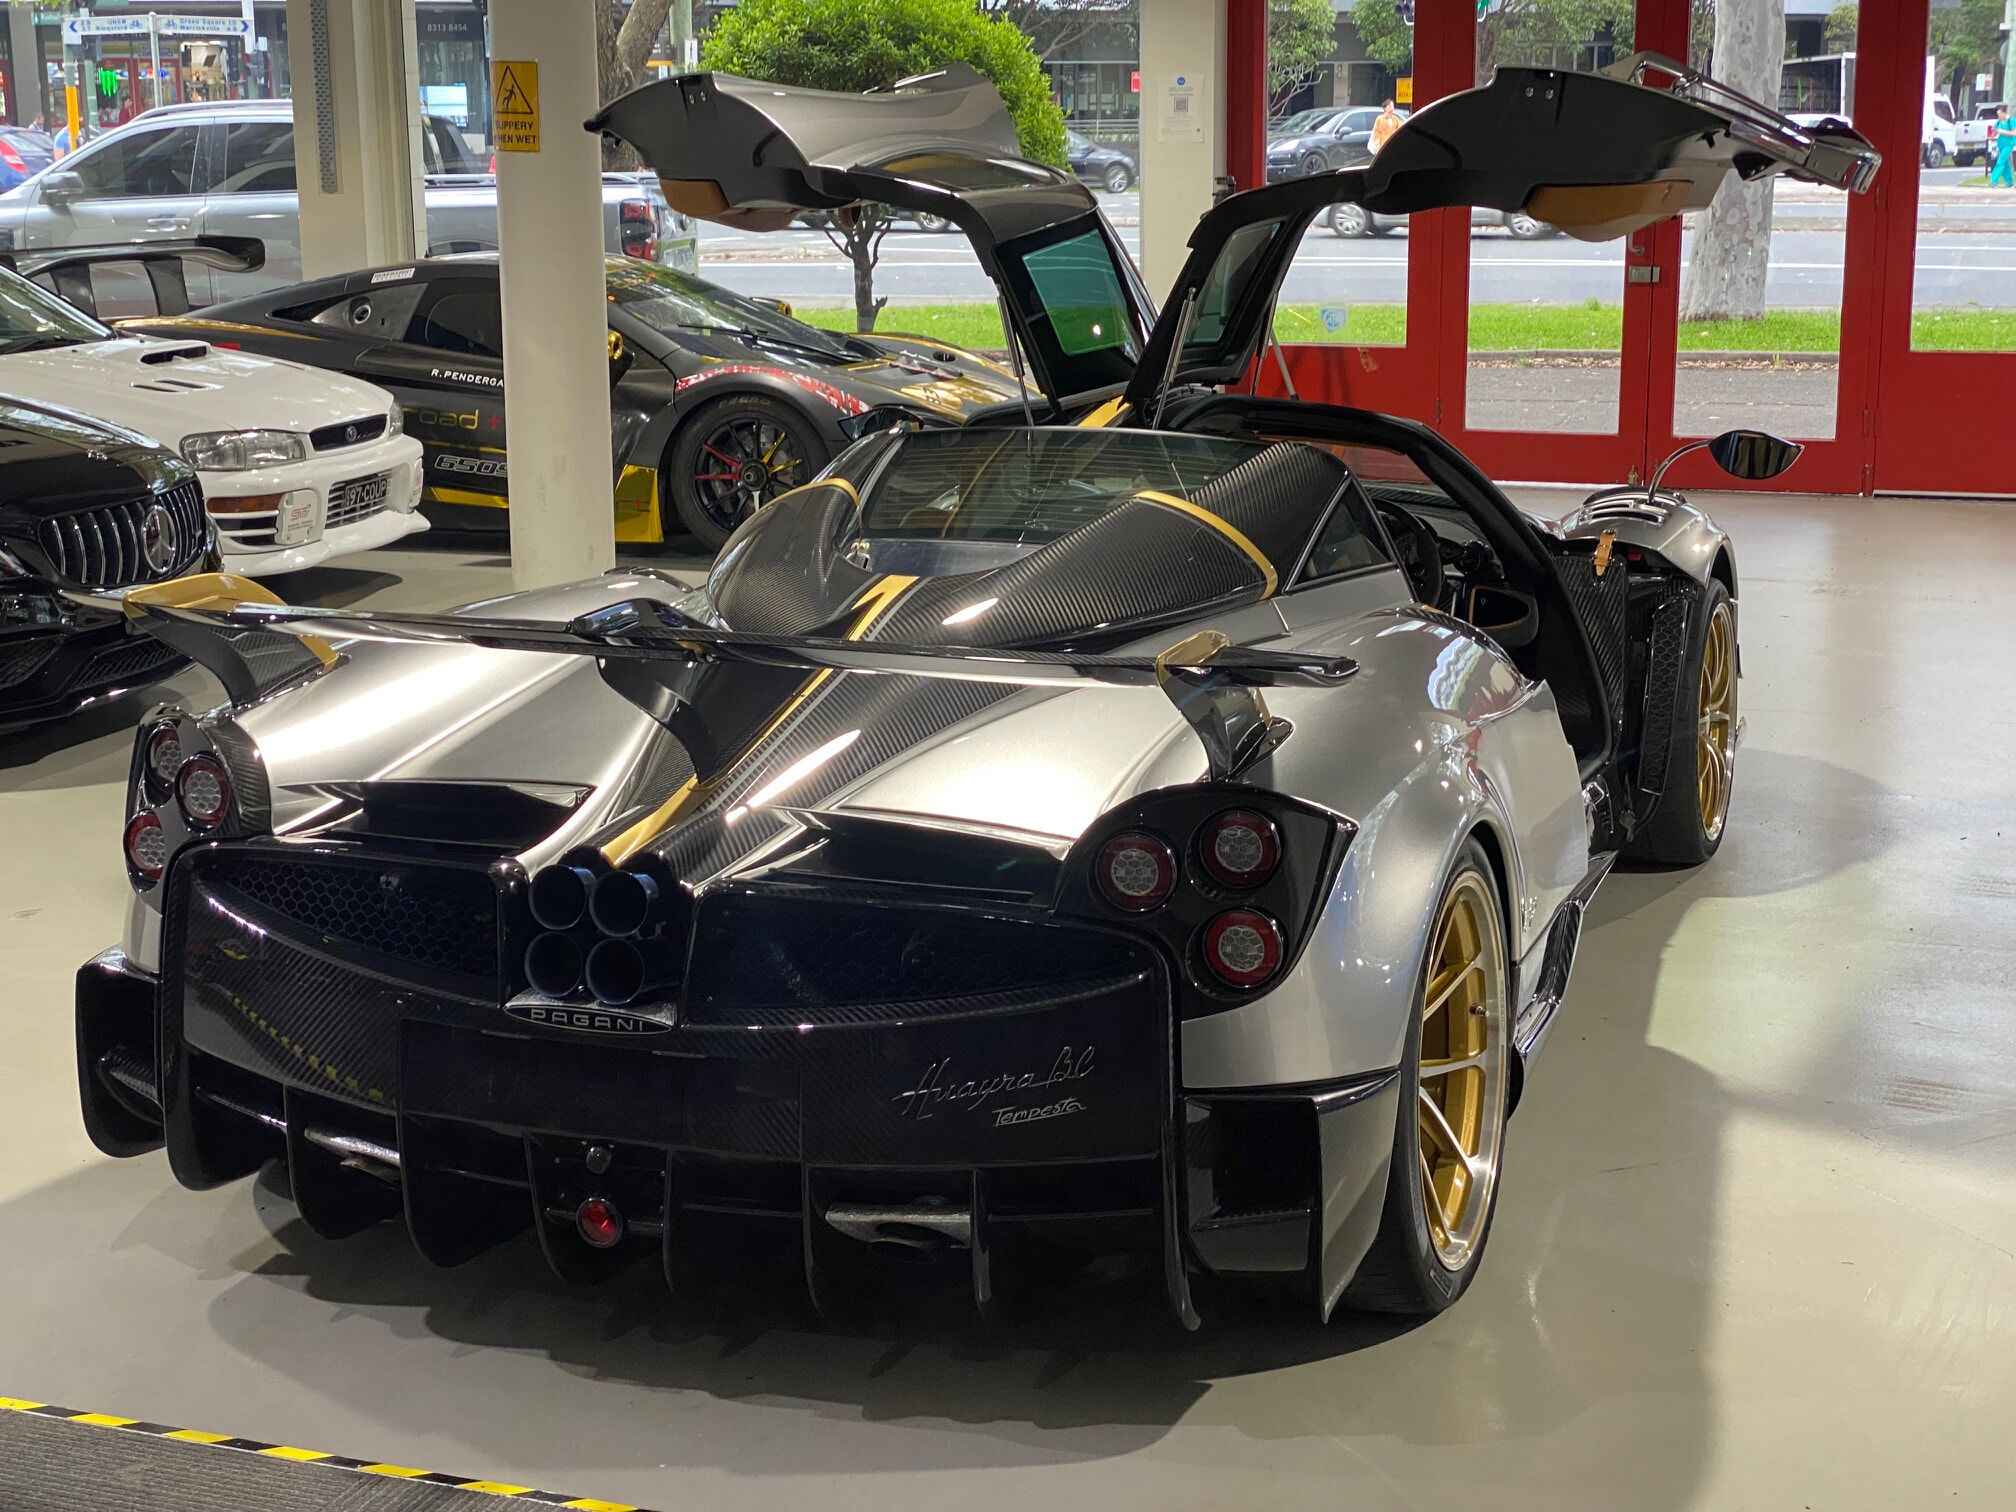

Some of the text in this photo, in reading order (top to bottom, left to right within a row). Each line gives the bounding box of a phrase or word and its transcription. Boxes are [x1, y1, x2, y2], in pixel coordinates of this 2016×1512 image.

[202, 18, 226, 26] Square
[515, 134, 537, 144] WET
[530, 1008, 643, 1032] PAGANI
[892, 1057, 1035, 1120] Huayra
[991, 1096, 1088, 1128] Tempesta
